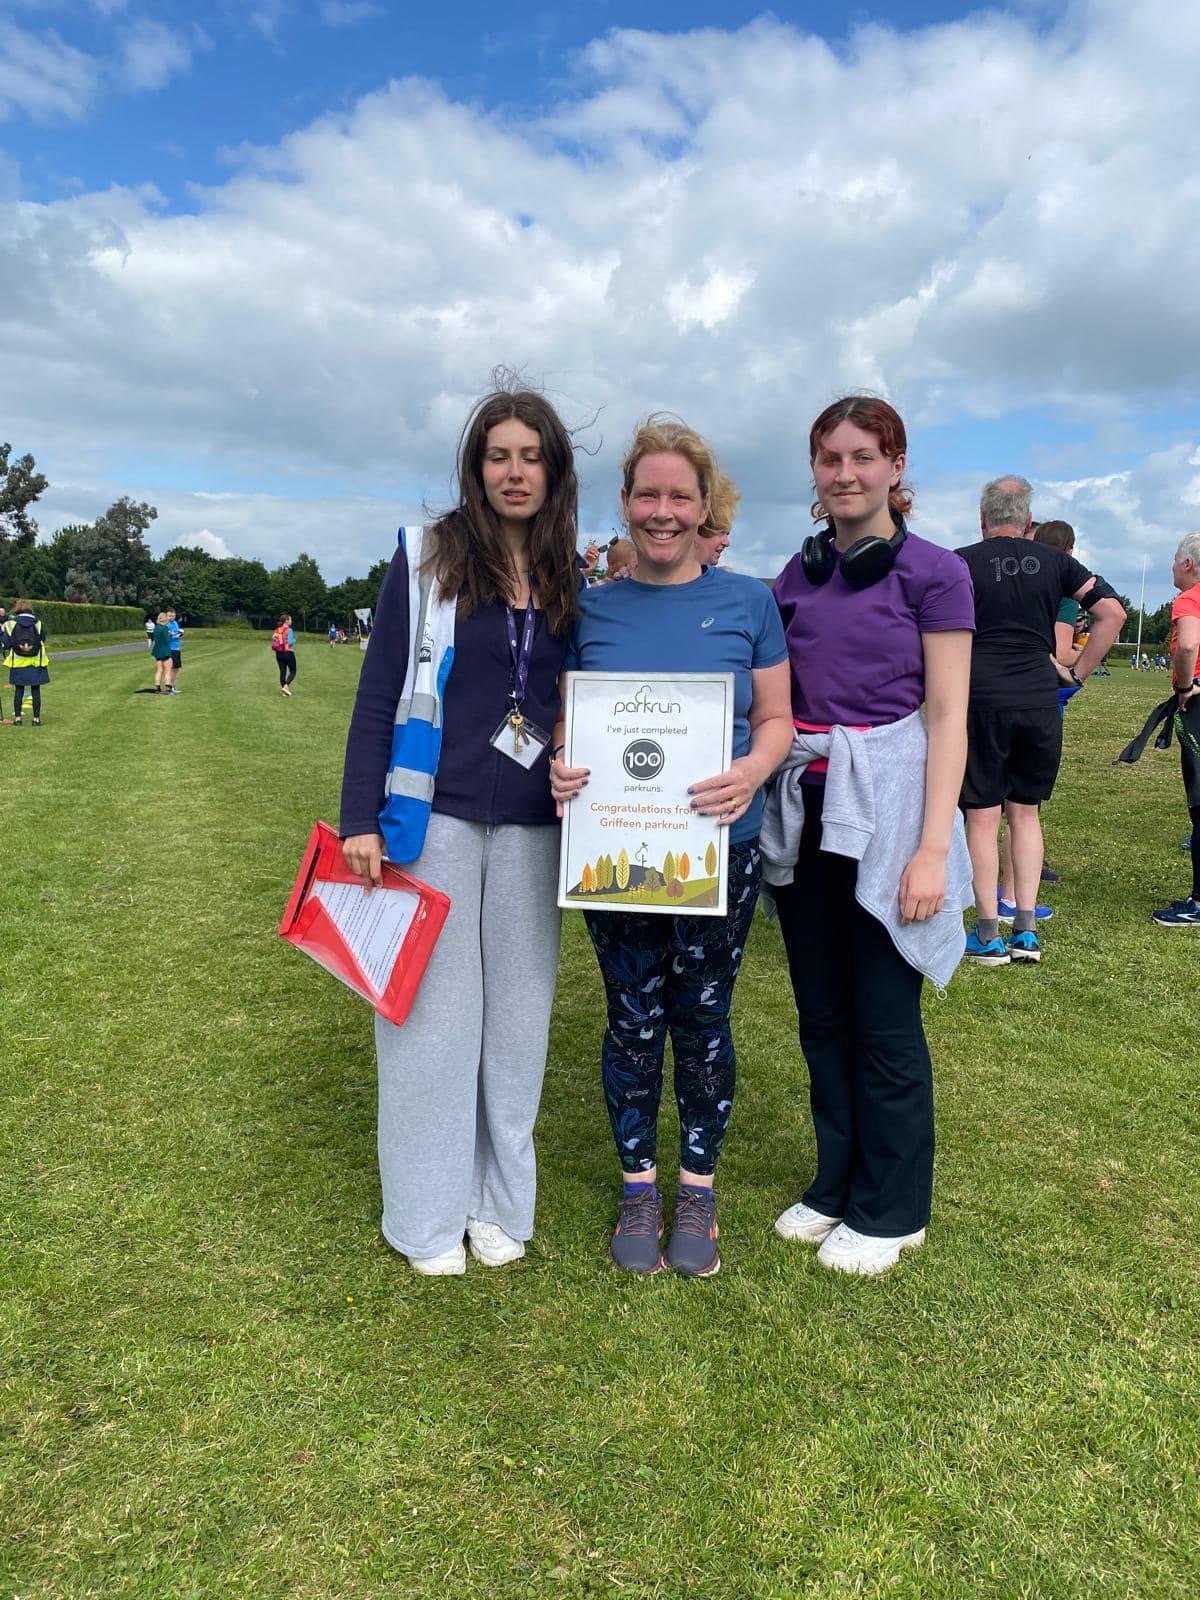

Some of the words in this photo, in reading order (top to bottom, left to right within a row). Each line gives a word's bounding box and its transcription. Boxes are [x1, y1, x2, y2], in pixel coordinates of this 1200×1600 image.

[990, 556, 1040, 582] 100
[614, 690, 681, 716] parkrun
[607, 725, 622, 733] I've
[624, 726, 639, 735] just
[642, 726, 688, 736] completed
[627, 752, 661, 769] 100
[624, 784, 663, 793] parkruns.
[591, 802, 672, 815] Congratulations
[600, 817, 641, 829] Griffeen
[644, 820, 688, 831] parkrun!
